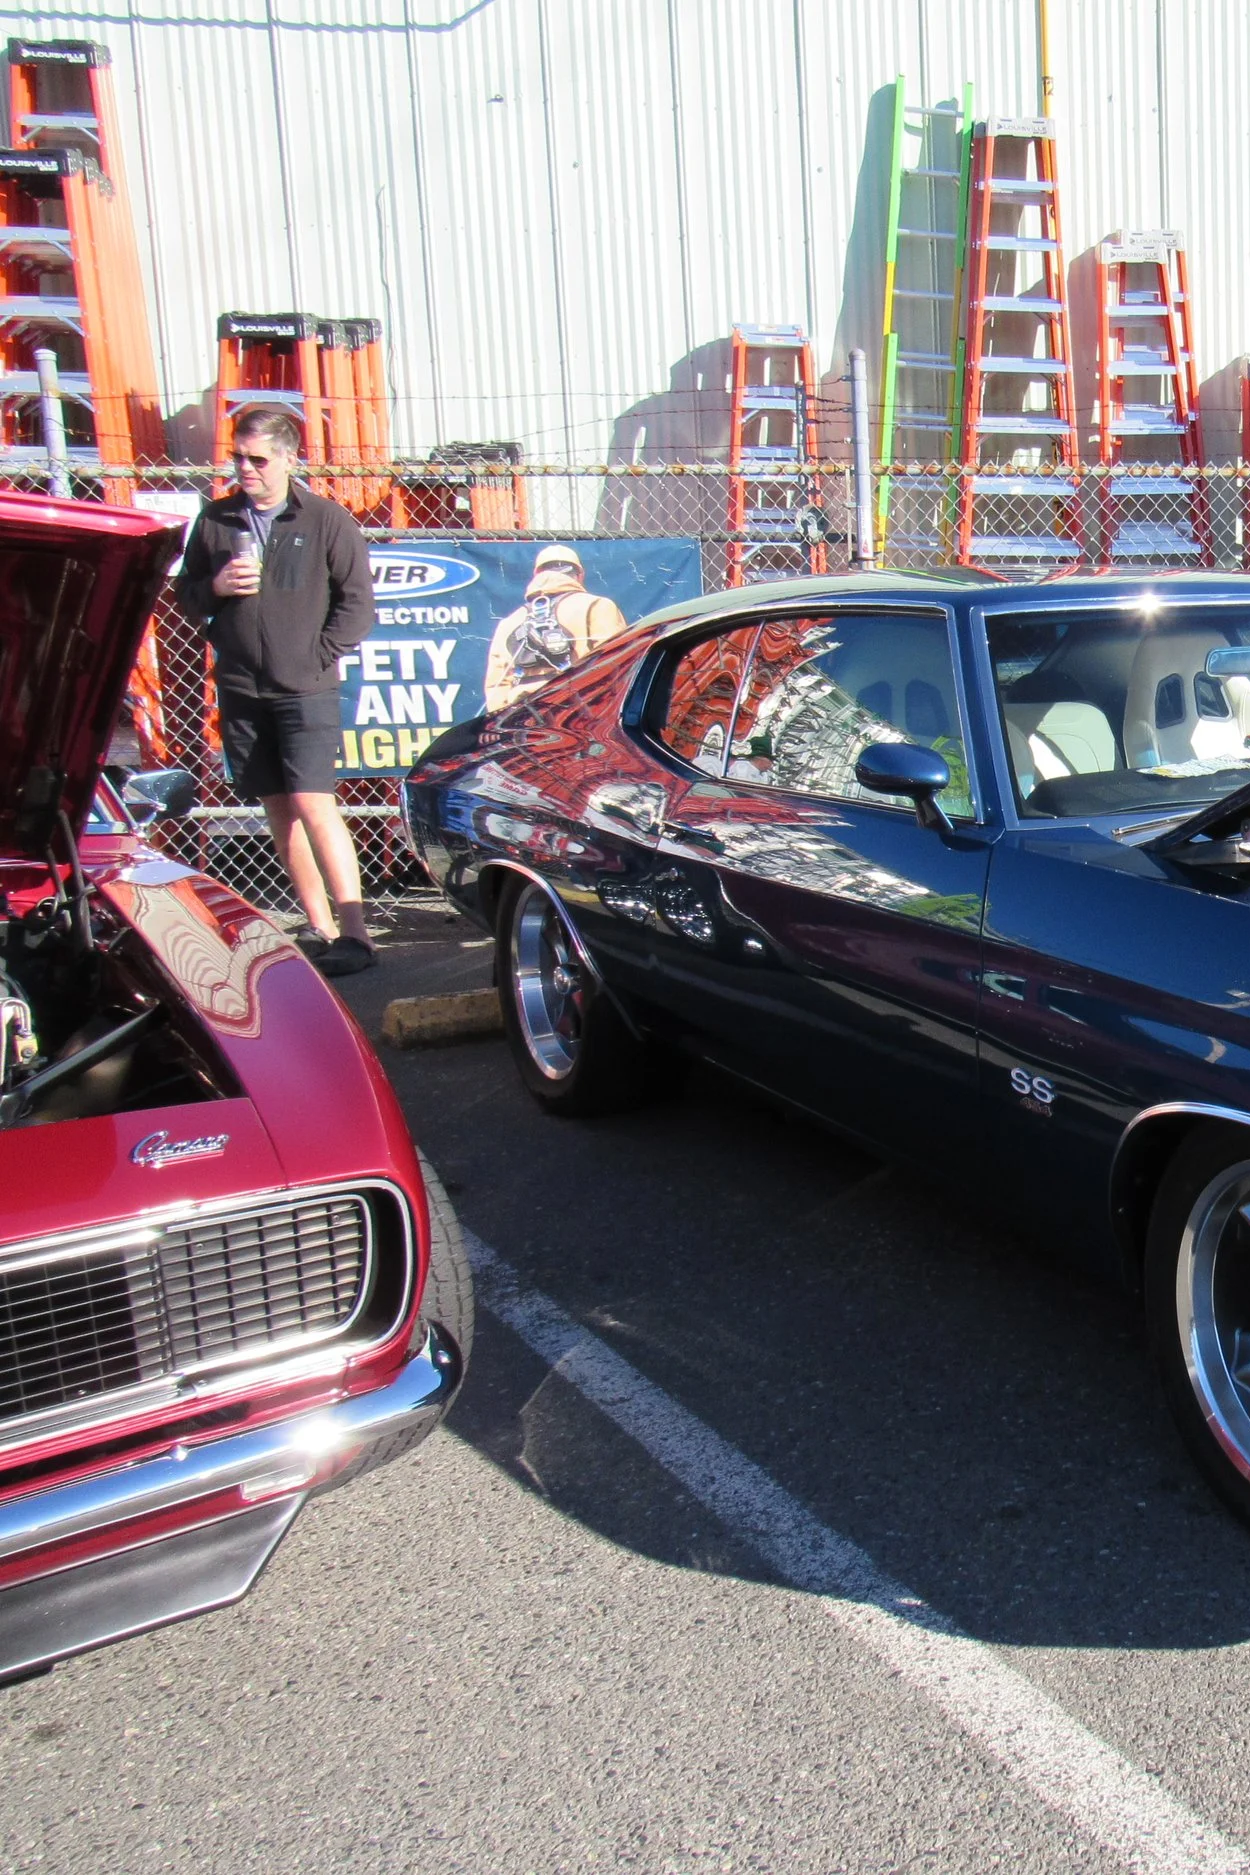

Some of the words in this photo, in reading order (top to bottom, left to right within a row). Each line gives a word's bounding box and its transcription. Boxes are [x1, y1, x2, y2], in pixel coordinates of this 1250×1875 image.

[32, 51, 86, 60] LOUISVILLE
[240, 325, 295, 333] LOUISVILLE
[375, 606, 469, 625] ECTION
[355, 684, 461, 725] ANY
[334, 727, 450, 768] IGH
[1011, 1067, 1053, 1103] SS
[133, 1130, 229, 1164] Camaro
